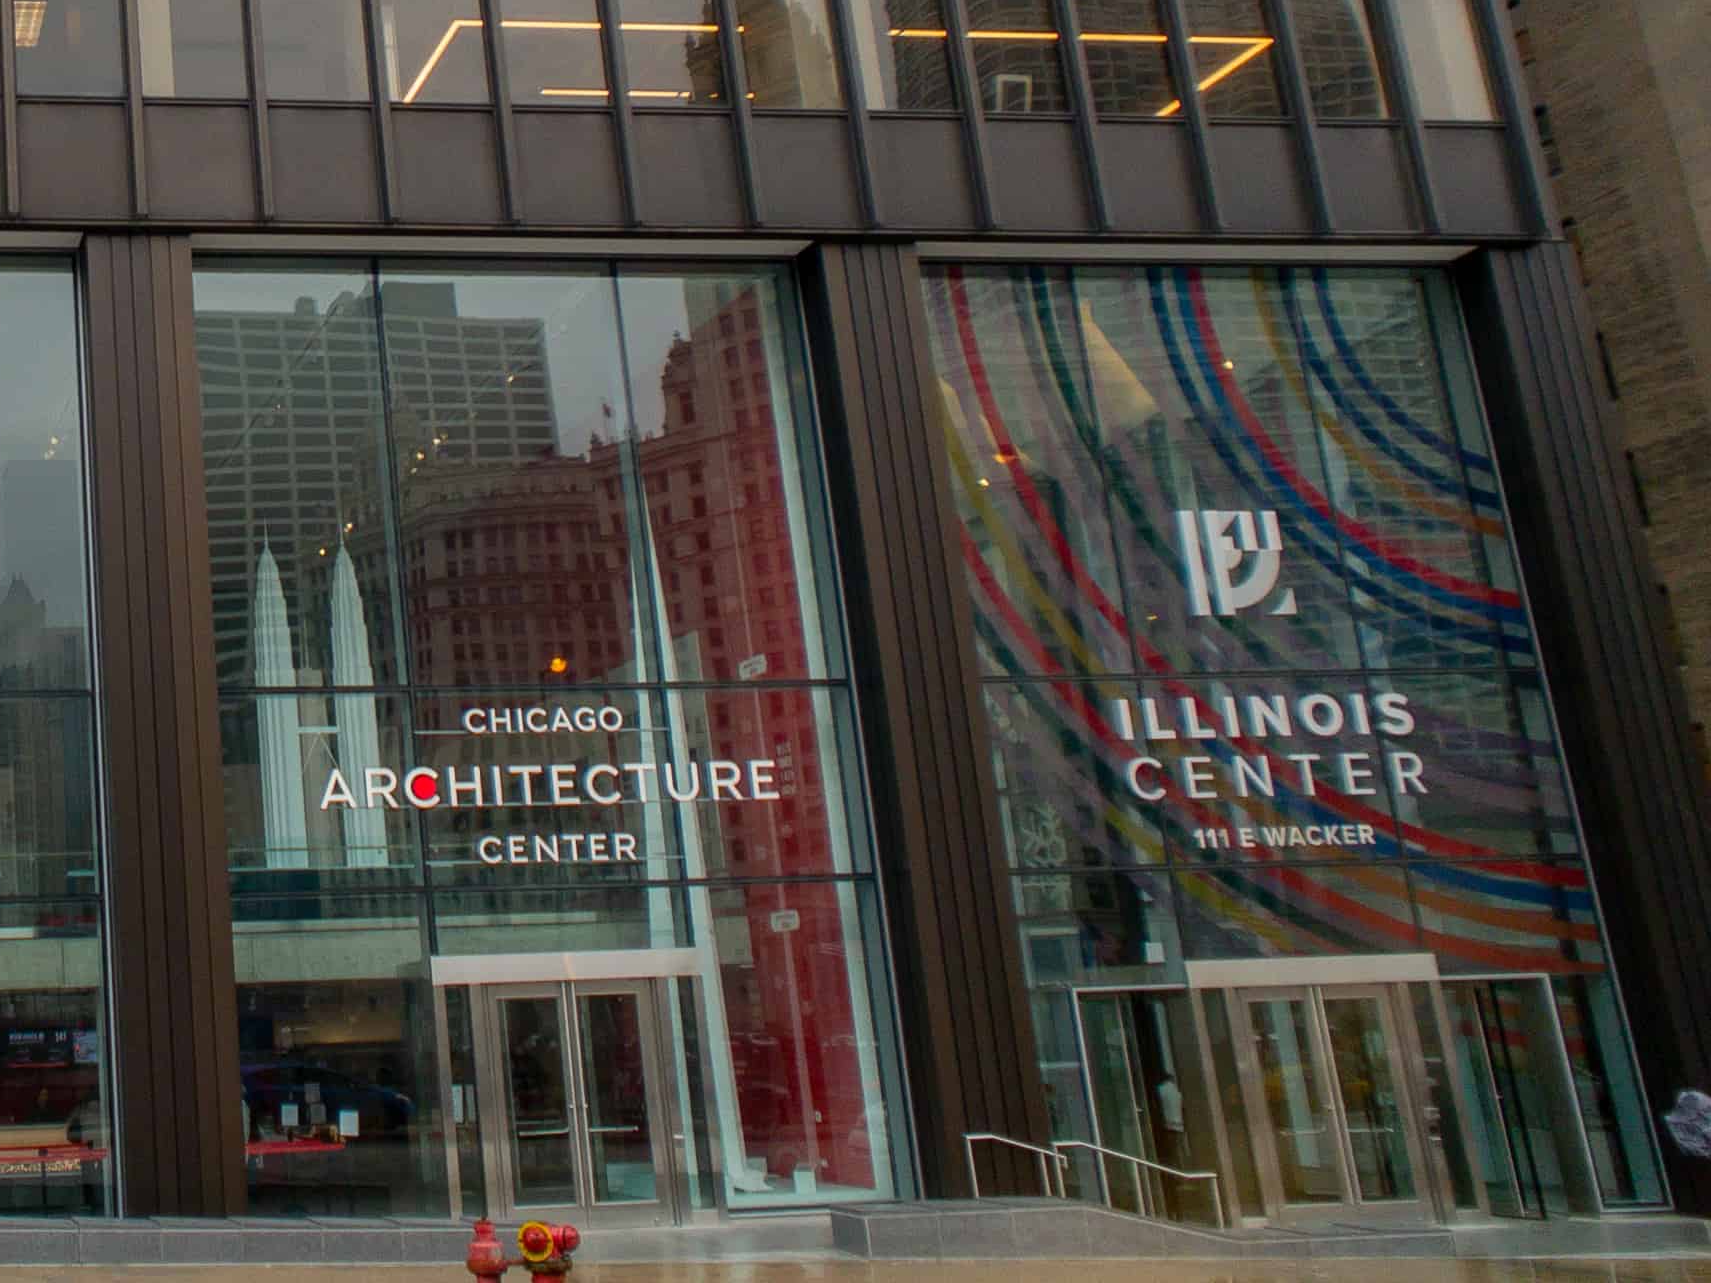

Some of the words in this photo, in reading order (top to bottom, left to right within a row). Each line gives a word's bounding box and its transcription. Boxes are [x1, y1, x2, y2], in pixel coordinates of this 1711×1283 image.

[463, 705, 624, 734] CHICAGO
[1113, 692, 1415, 740] ILLINOIS
[320, 759, 781, 809] ARCHITECTURE
[1126, 752, 1429, 800] CENTER
[478, 833, 638, 865] CENTER
[1194, 827, 1232, 849] 111
[1239, 827, 1258, 847] E
[1263, 823, 1376, 847] WACKER
